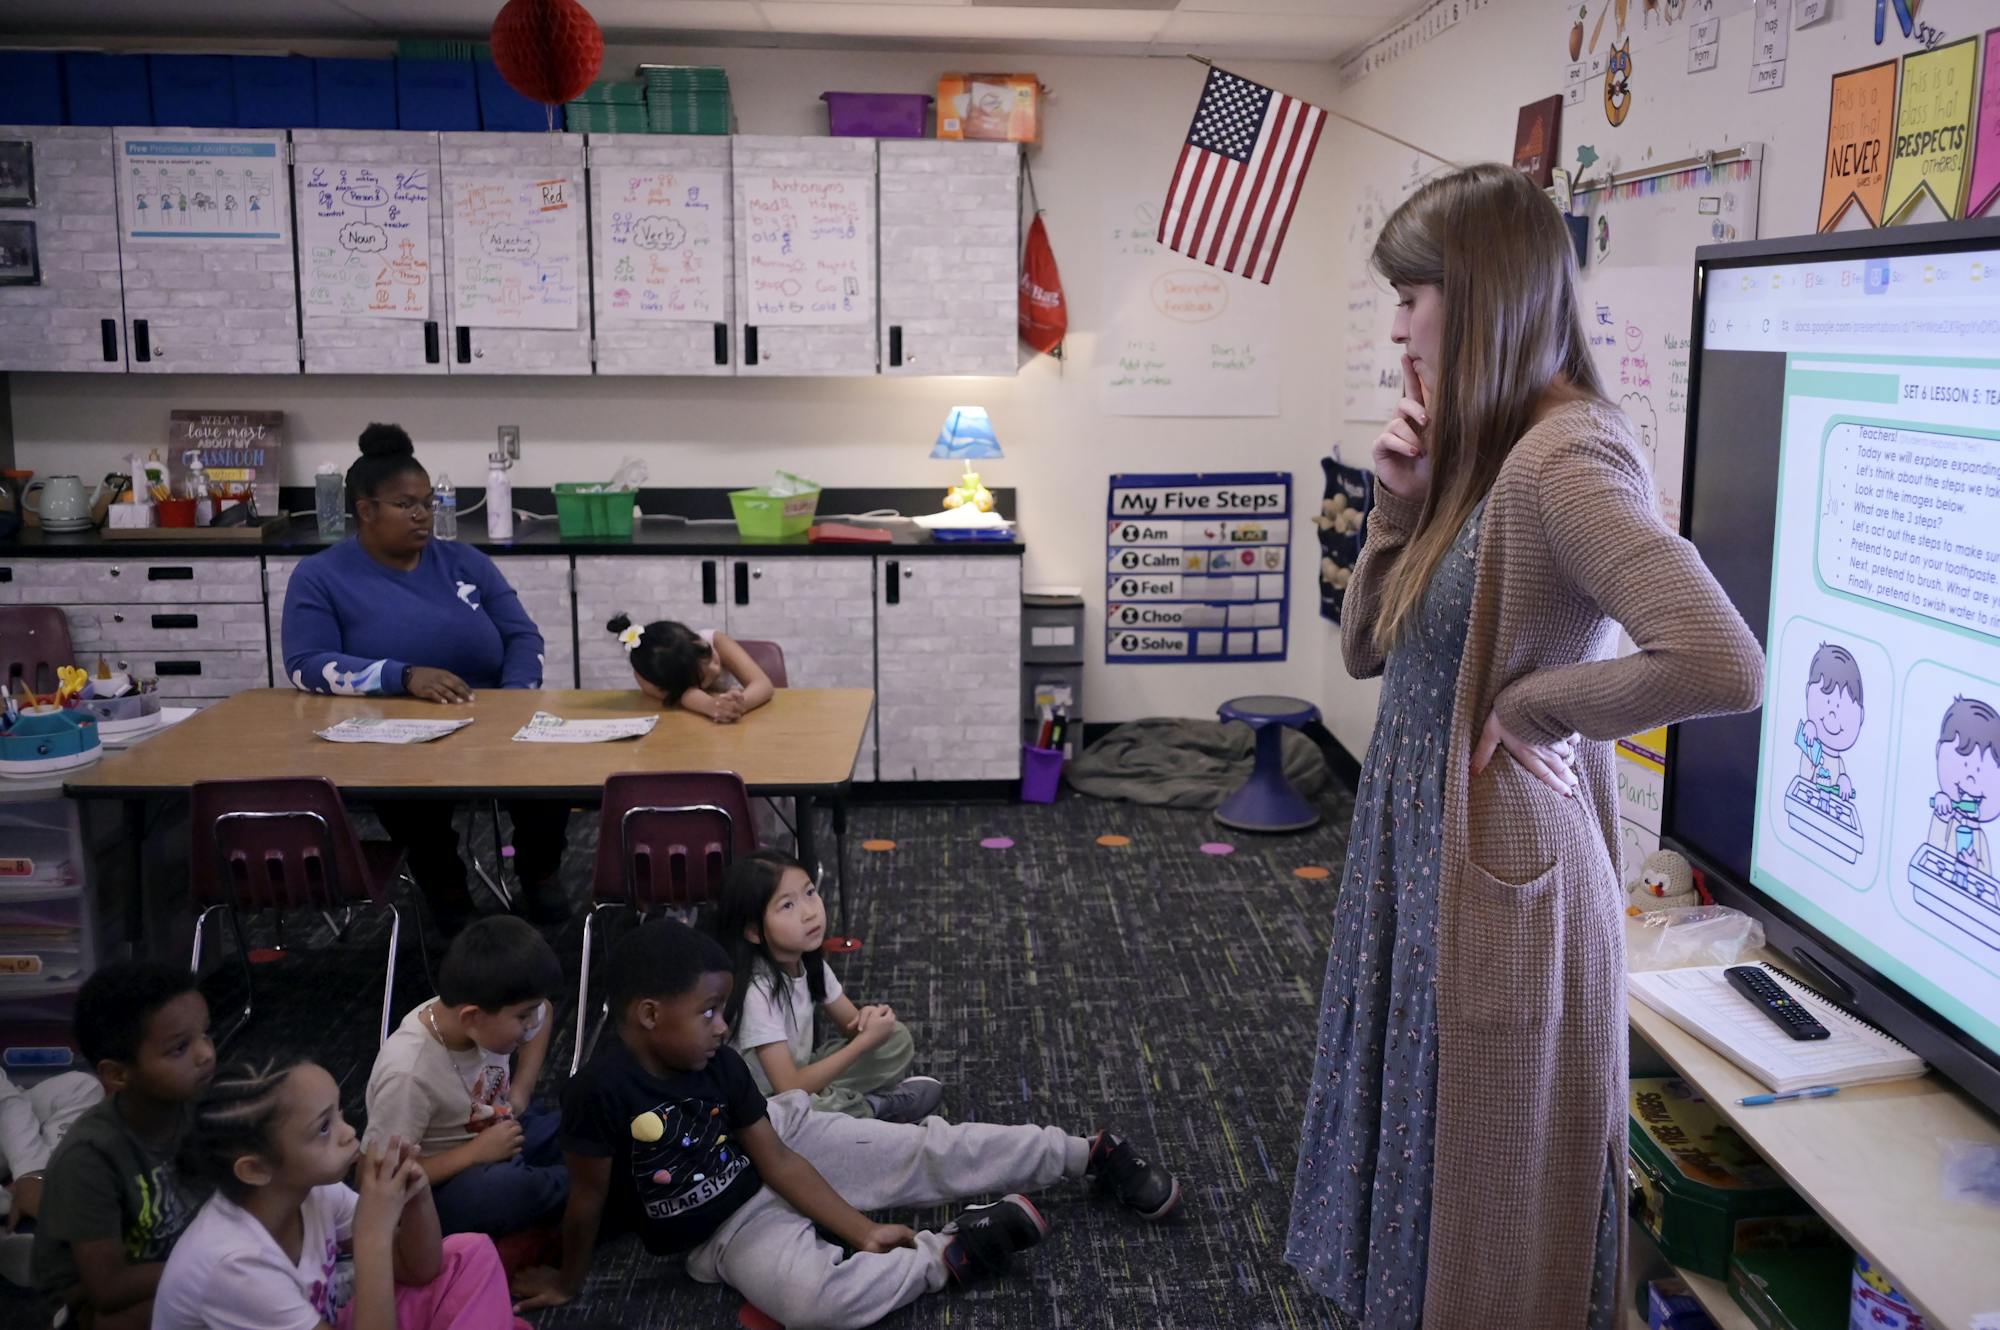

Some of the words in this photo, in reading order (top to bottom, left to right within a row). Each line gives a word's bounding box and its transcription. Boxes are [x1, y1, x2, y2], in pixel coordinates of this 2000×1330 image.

[1896, 124, 1966, 160] RESPECTS
[1830, 139, 1881, 179] NEVER
[542, 185, 563, 205] Red
[772, 178, 845, 200] Antonyms
[349, 231, 376, 244] Noun
[490, 234, 532, 249] Adjective
[642, 226, 675, 242] Verb
[1903, 384, 1920, 399] SET
[1922, 386, 1927, 400] 6
[1930, 386, 1970, 403] LESSON
[1973, 388, 1982, 404] 5:
[201, 415, 239, 425] WHAT
[185, 422, 221, 439] love
[227, 424, 266, 440] most
[1859, 426, 1898, 442] Teachers!
[198, 439, 232, 449] ABOUT
[234, 439, 251, 449] MY
[182, 449, 264, 467] CASSROOM
[1857, 445, 1882, 461] Today
[1884, 452, 1896, 461] we
[1899, 452, 1912, 464] will
[1914, 454, 1949, 471] explore
[1856, 464, 1874, 478] Let's
[1875, 466, 1895, 480] think
[1898, 471, 1924, 485] about
[1925, 475, 1940, 487] the
[1941, 476, 1966, 493] steps
[1968, 485, 1983, 495] we
[1121, 493, 1158, 515] My
[1165, 491, 1211, 509] Five
[1216, 490, 1278, 511] Steps
[1855, 483, 1874, 496] Look
[1875, 487, 1885, 498] at
[1886, 488, 1899, 502] the
[1901, 490, 1934, 509] images
[1936, 498, 1967, 514] below.
[1853, 501, 1874, 516] What
[1875, 507, 1890, 518] are
[1891, 508, 1905, 521] the
[1907, 510, 1913, 524] 3
[1914, 512, 1944, 530] steps?
[1142, 528, 1168, 540] Am
[1852, 519, 1870, 534] Let's
[1872, 524, 1886, 537] act
[1887, 528, 1901, 541] out
[1902, 530, 1916, 545] the
[1918, 535, 1942, 551] steps
[1944, 539, 1953, 552] to
[1955, 542, 1983, 560] make
[1142, 551, 1180, 566] Calm
[1851, 538, 1882, 555] Pretend
[1883, 545, 1891, 557] to
[1893, 548, 1908, 562] put
[1909, 554, 1921, 564] on
[1922, 558, 1944, 573] your
[1945, 560, 1999, 585] toothpaste.
[1141, 581, 1174, 595] Feel
[1872, 563, 1904, 582] pretend
[1906, 570, 1915, 584] to
[1917, 571, 1944, 592] brush.
[1946, 580, 1972, 600] What
[1973, 590, 1989, 603] are
[1876, 584, 1909, 603] pretend
[1911, 591, 1921, 605] to
[1922, 594, 1946, 612] swish
[1949, 602, 1976, 621] water
[1978, 610, 1988, 625] to
[1142, 607, 1182, 623] Choo
[1141, 634, 1184, 650] Solve
[1618, 773, 1659, 811] Plants
[650, 1192, 699, 1218] SOLAR
[702, 1155, 750, 1199] SYSTEM
